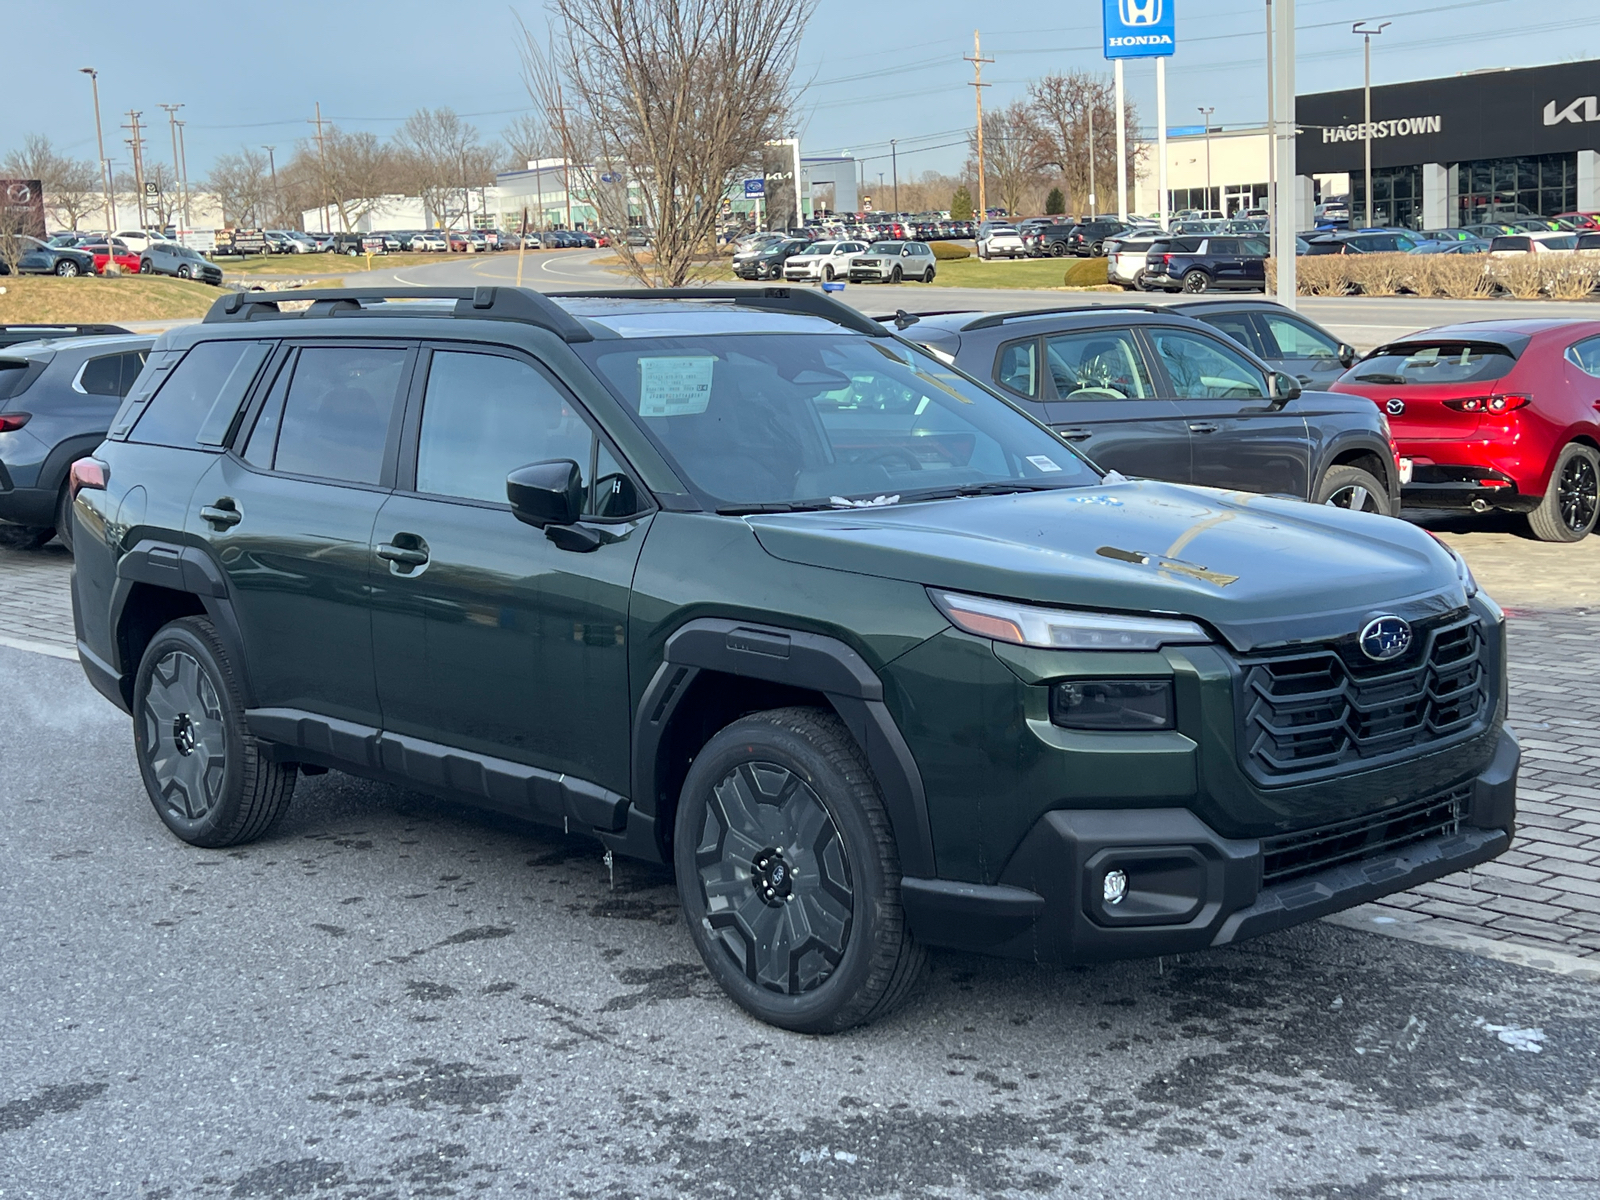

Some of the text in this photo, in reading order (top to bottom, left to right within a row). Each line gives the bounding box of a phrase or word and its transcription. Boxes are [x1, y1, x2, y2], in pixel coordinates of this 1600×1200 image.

[1108, 34, 1173, 47] HONDA
[1543, 95, 1600, 126] KI
[1322, 115, 1441, 144] HAGERSTOWN
